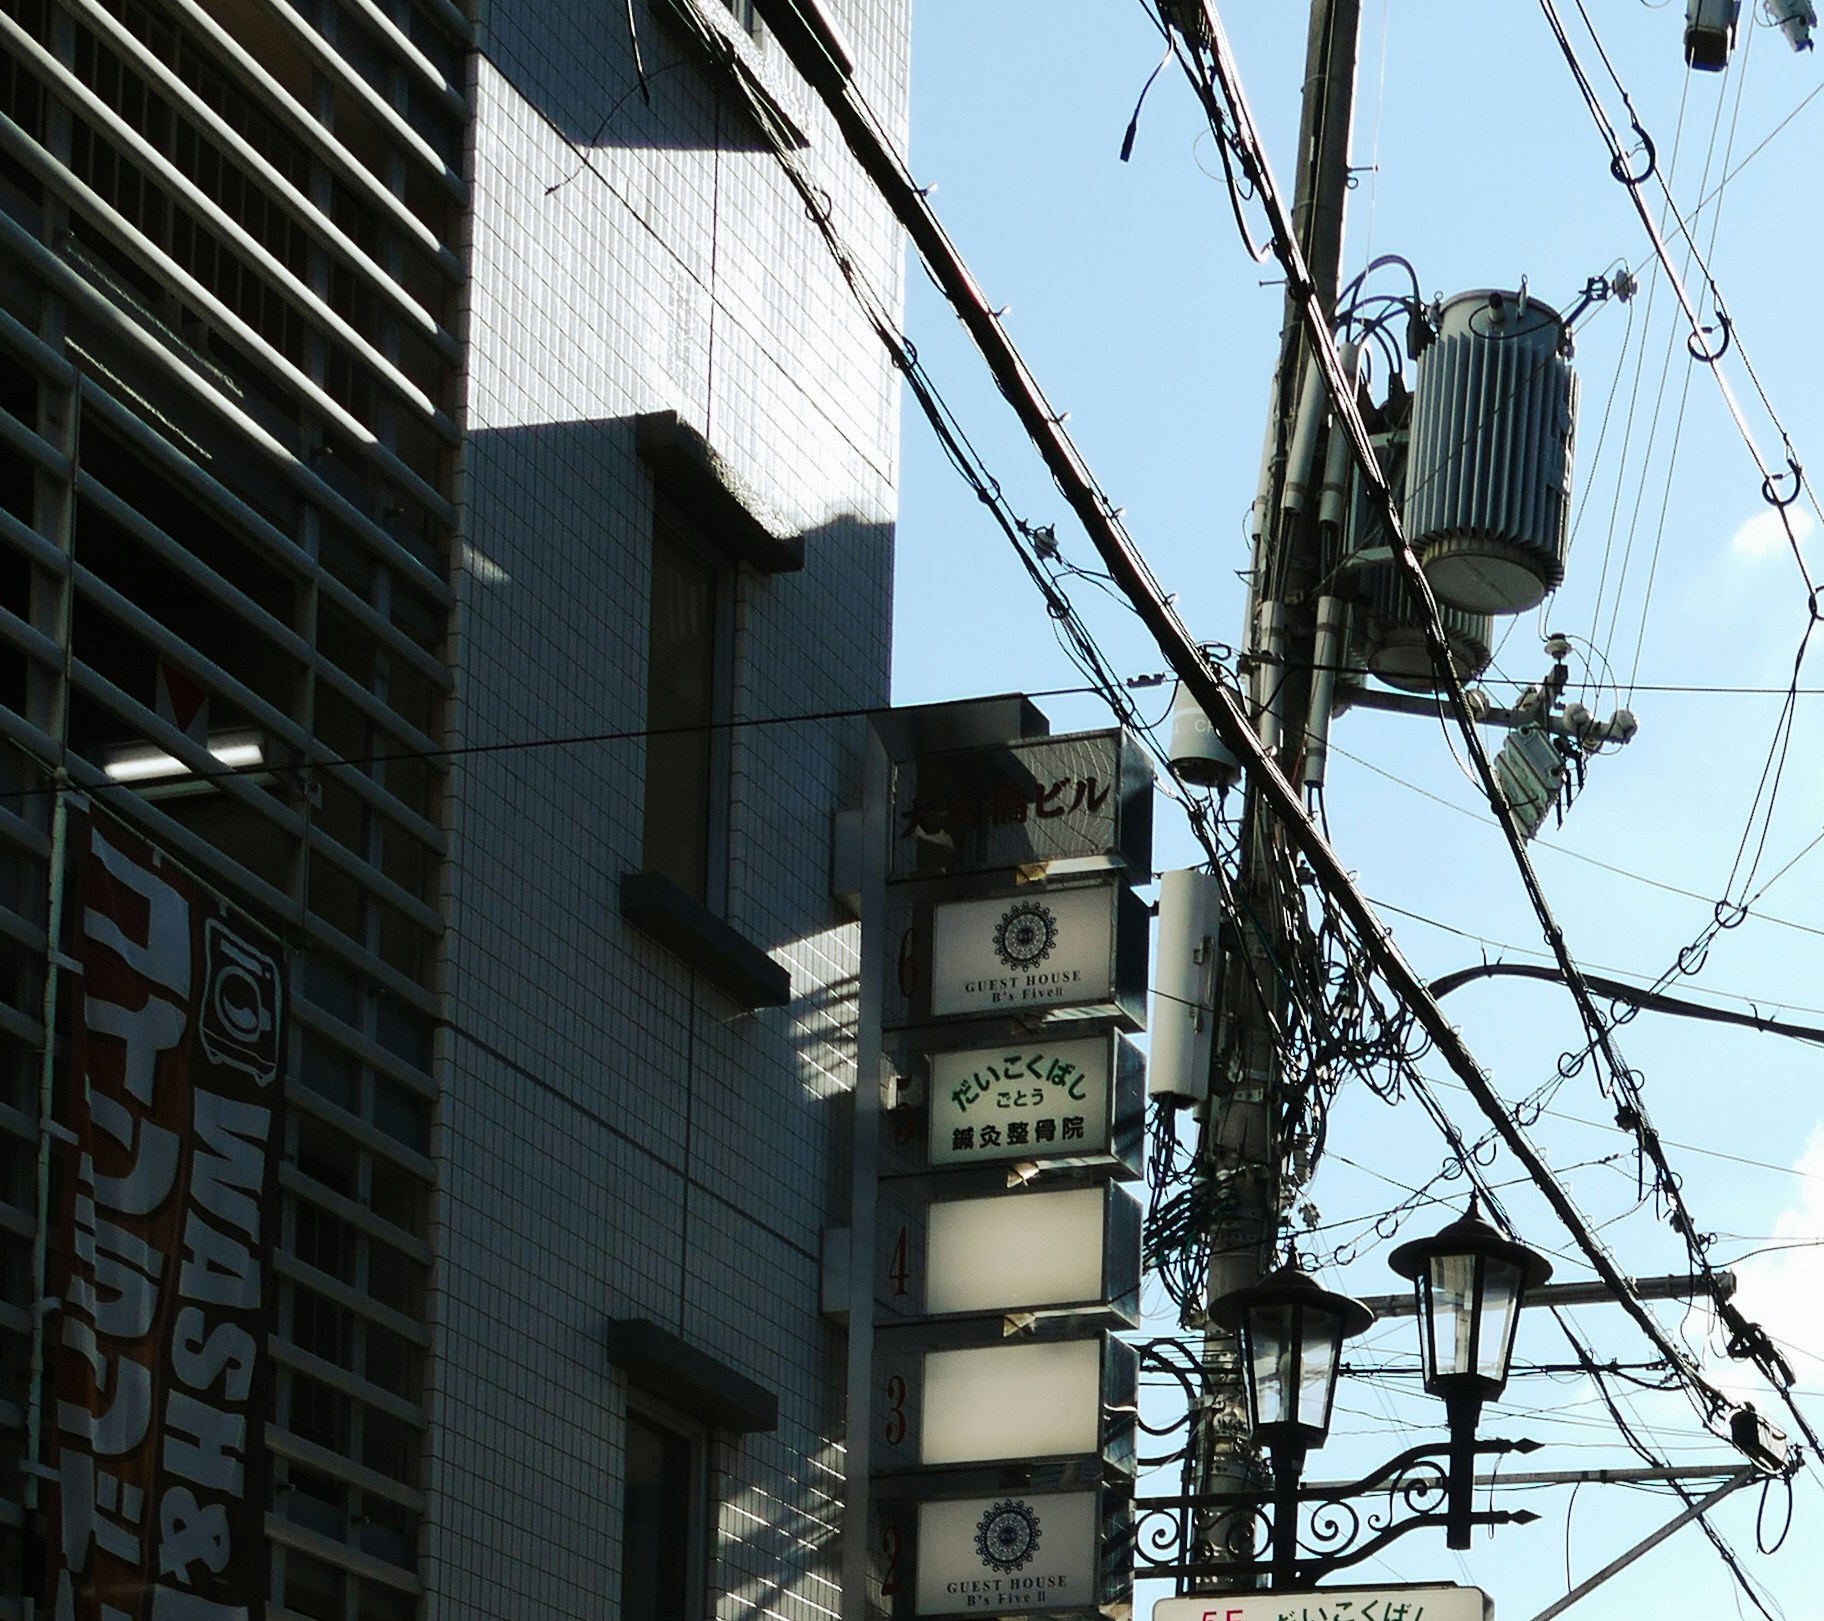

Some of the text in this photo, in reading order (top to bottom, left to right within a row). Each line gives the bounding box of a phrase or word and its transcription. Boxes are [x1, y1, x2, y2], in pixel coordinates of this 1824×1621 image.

[965, 970, 1082, 994] GUEST HOUSE
[951, 1054, 1086, 1112] だいこくばし
[997, 1087, 1044, 1109] ごとう
[952, 1116, 1085, 1151] 鍼灸整骨院
[947, 1574, 1067, 1595] GUEST HOUSE
